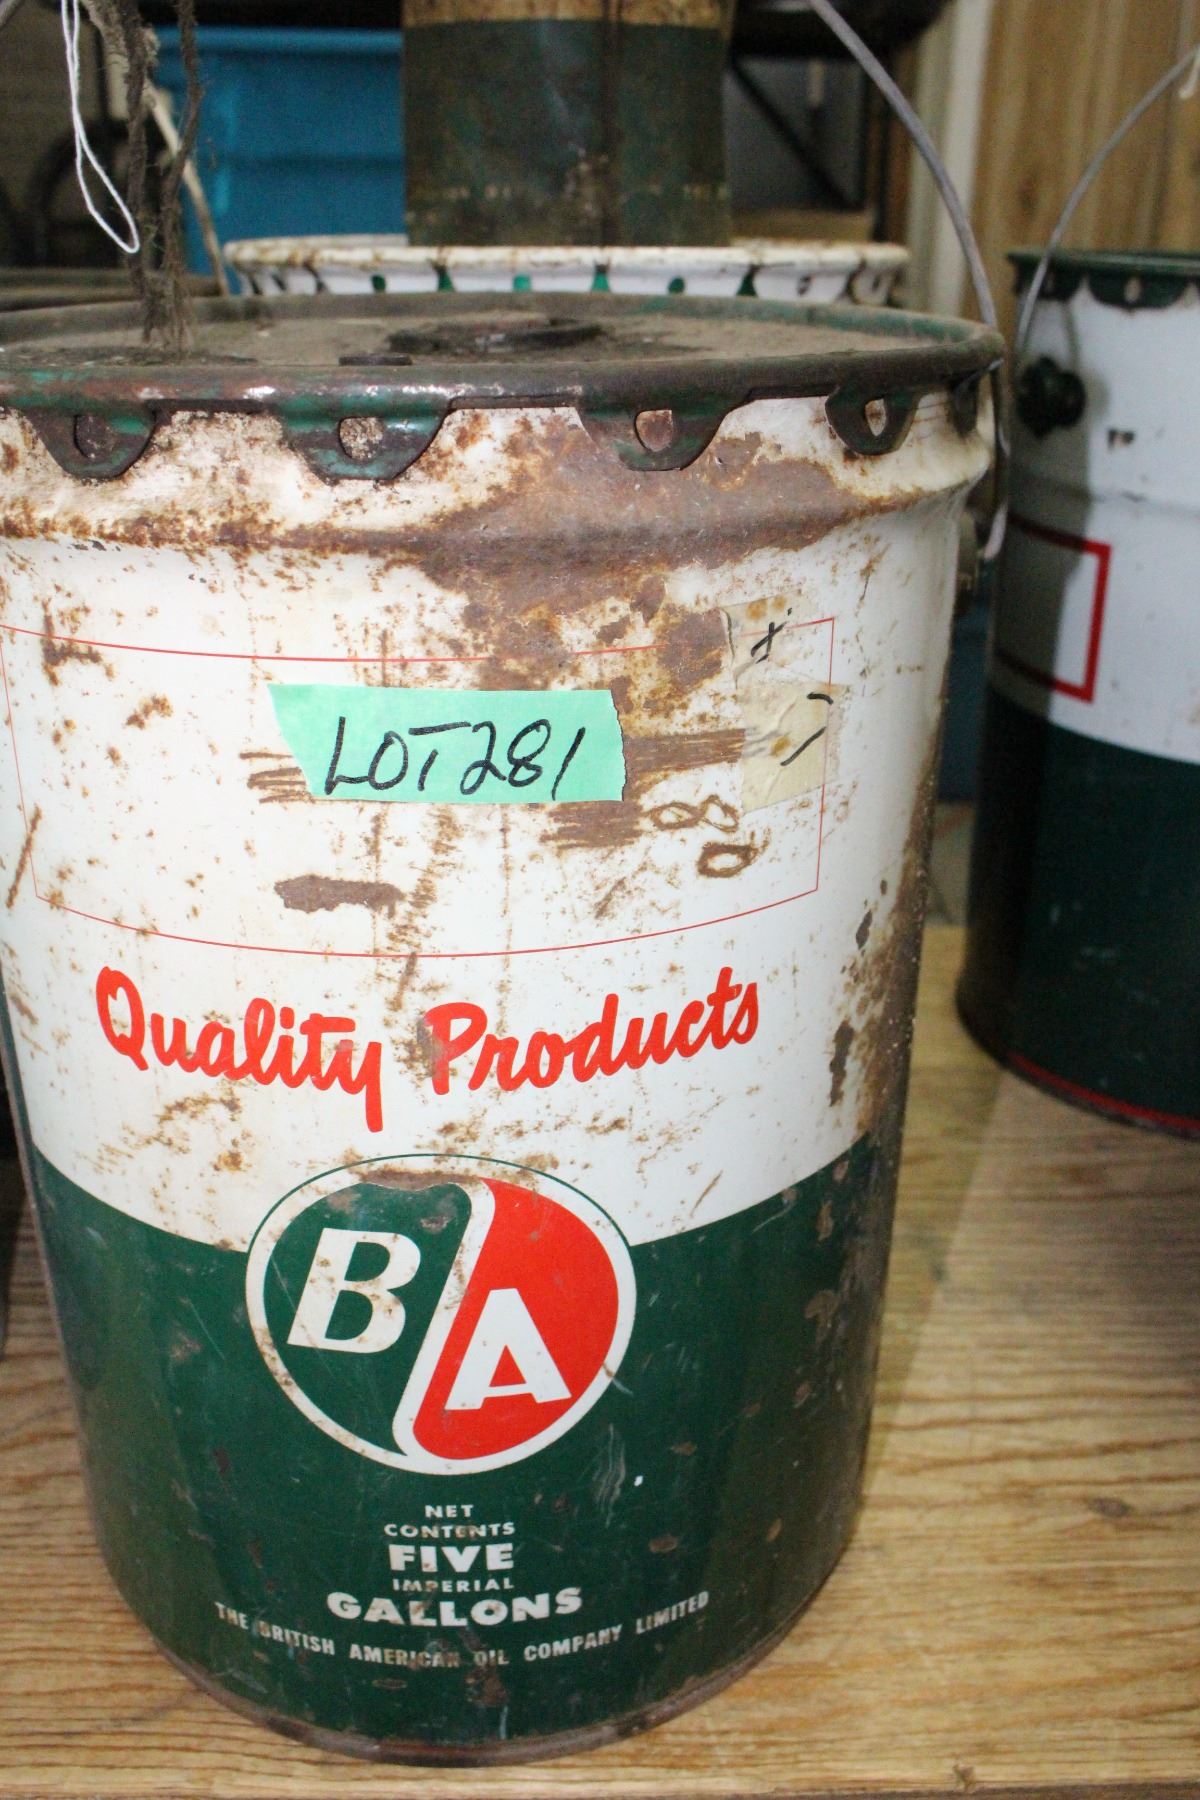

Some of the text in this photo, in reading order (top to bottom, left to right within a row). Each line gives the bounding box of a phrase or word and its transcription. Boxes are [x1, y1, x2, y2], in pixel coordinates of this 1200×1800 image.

[96, 965, 761, 1133] Quality Products
[424, 1504, 475, 1519] NET
[383, 1521, 516, 1540] CONTENTS
[388, 1542, 515, 1573] FIVE
[392, 1577, 515, 1594] IMPERIAL
[326, 1586, 583, 1627] GALLONS
[213, 1590, 710, 1669] THE BRITISH AMERICAN OIL COMPANY LIMITED
